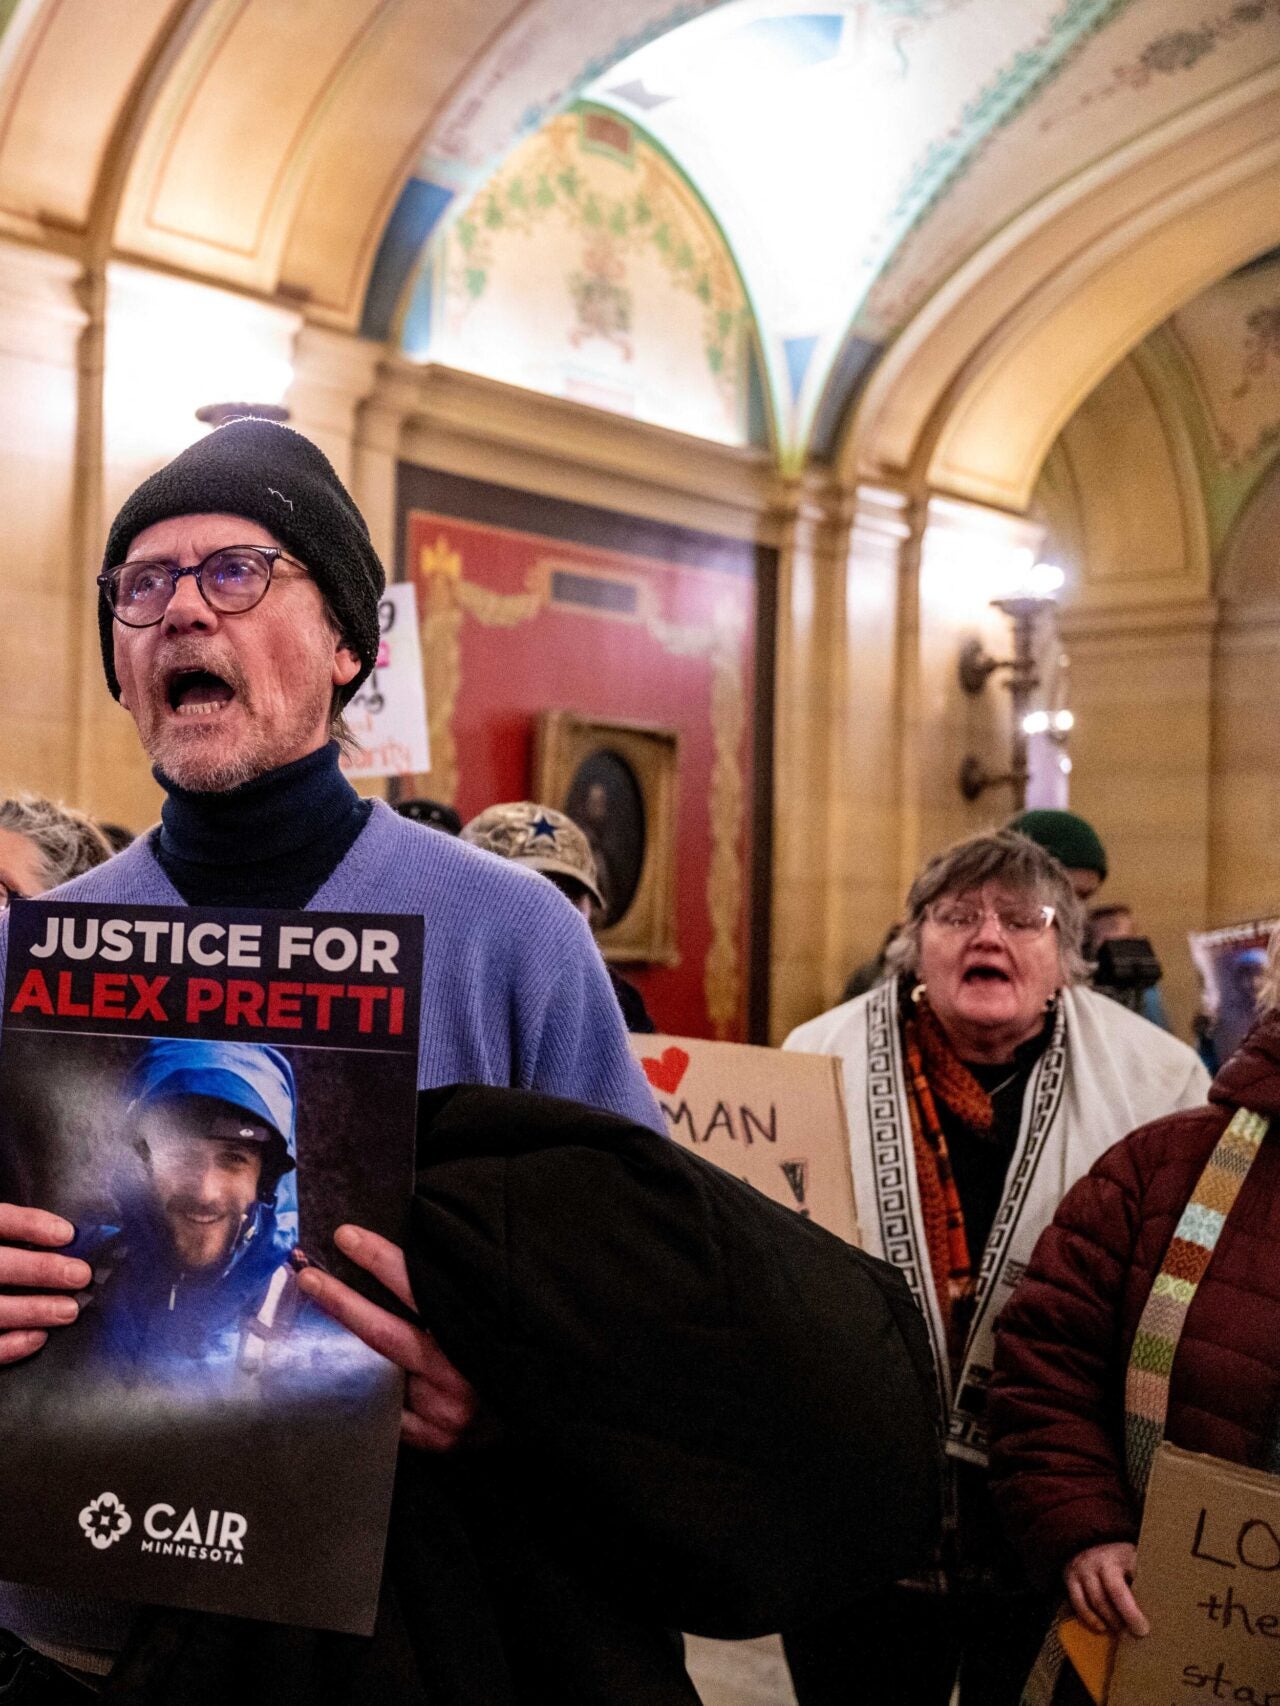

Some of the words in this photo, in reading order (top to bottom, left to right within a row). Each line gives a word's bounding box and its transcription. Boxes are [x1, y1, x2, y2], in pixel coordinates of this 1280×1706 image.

[29, 916, 262, 968] JUSTICE
[277, 926, 400, 974] FOR
[10, 969, 170, 1022] ALEX
[185, 977, 406, 1036] PRETTI
[141, 1539, 244, 1565] MINNESOTA
[143, 1502, 248, 1550] CAIR
